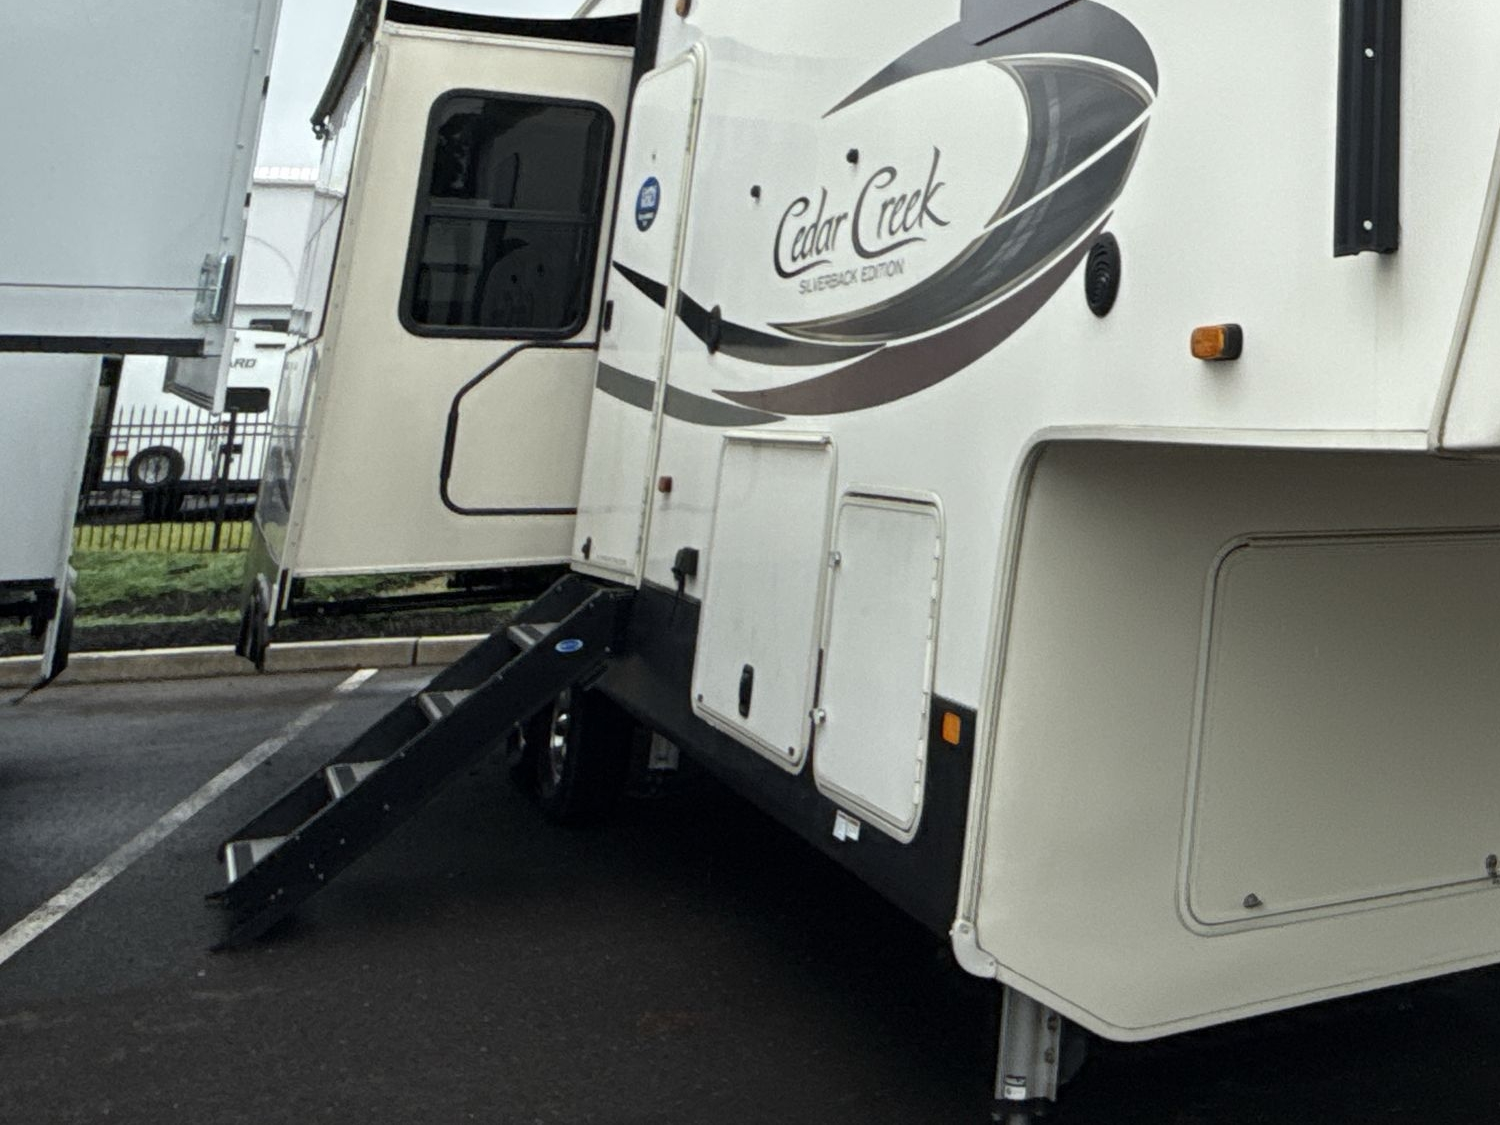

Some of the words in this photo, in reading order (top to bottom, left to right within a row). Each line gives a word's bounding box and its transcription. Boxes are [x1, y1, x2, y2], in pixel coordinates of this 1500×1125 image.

[773, 186, 849, 279] Cedar
[851, 145, 951, 259] Creek
[860, 258, 906, 283] EDITION
